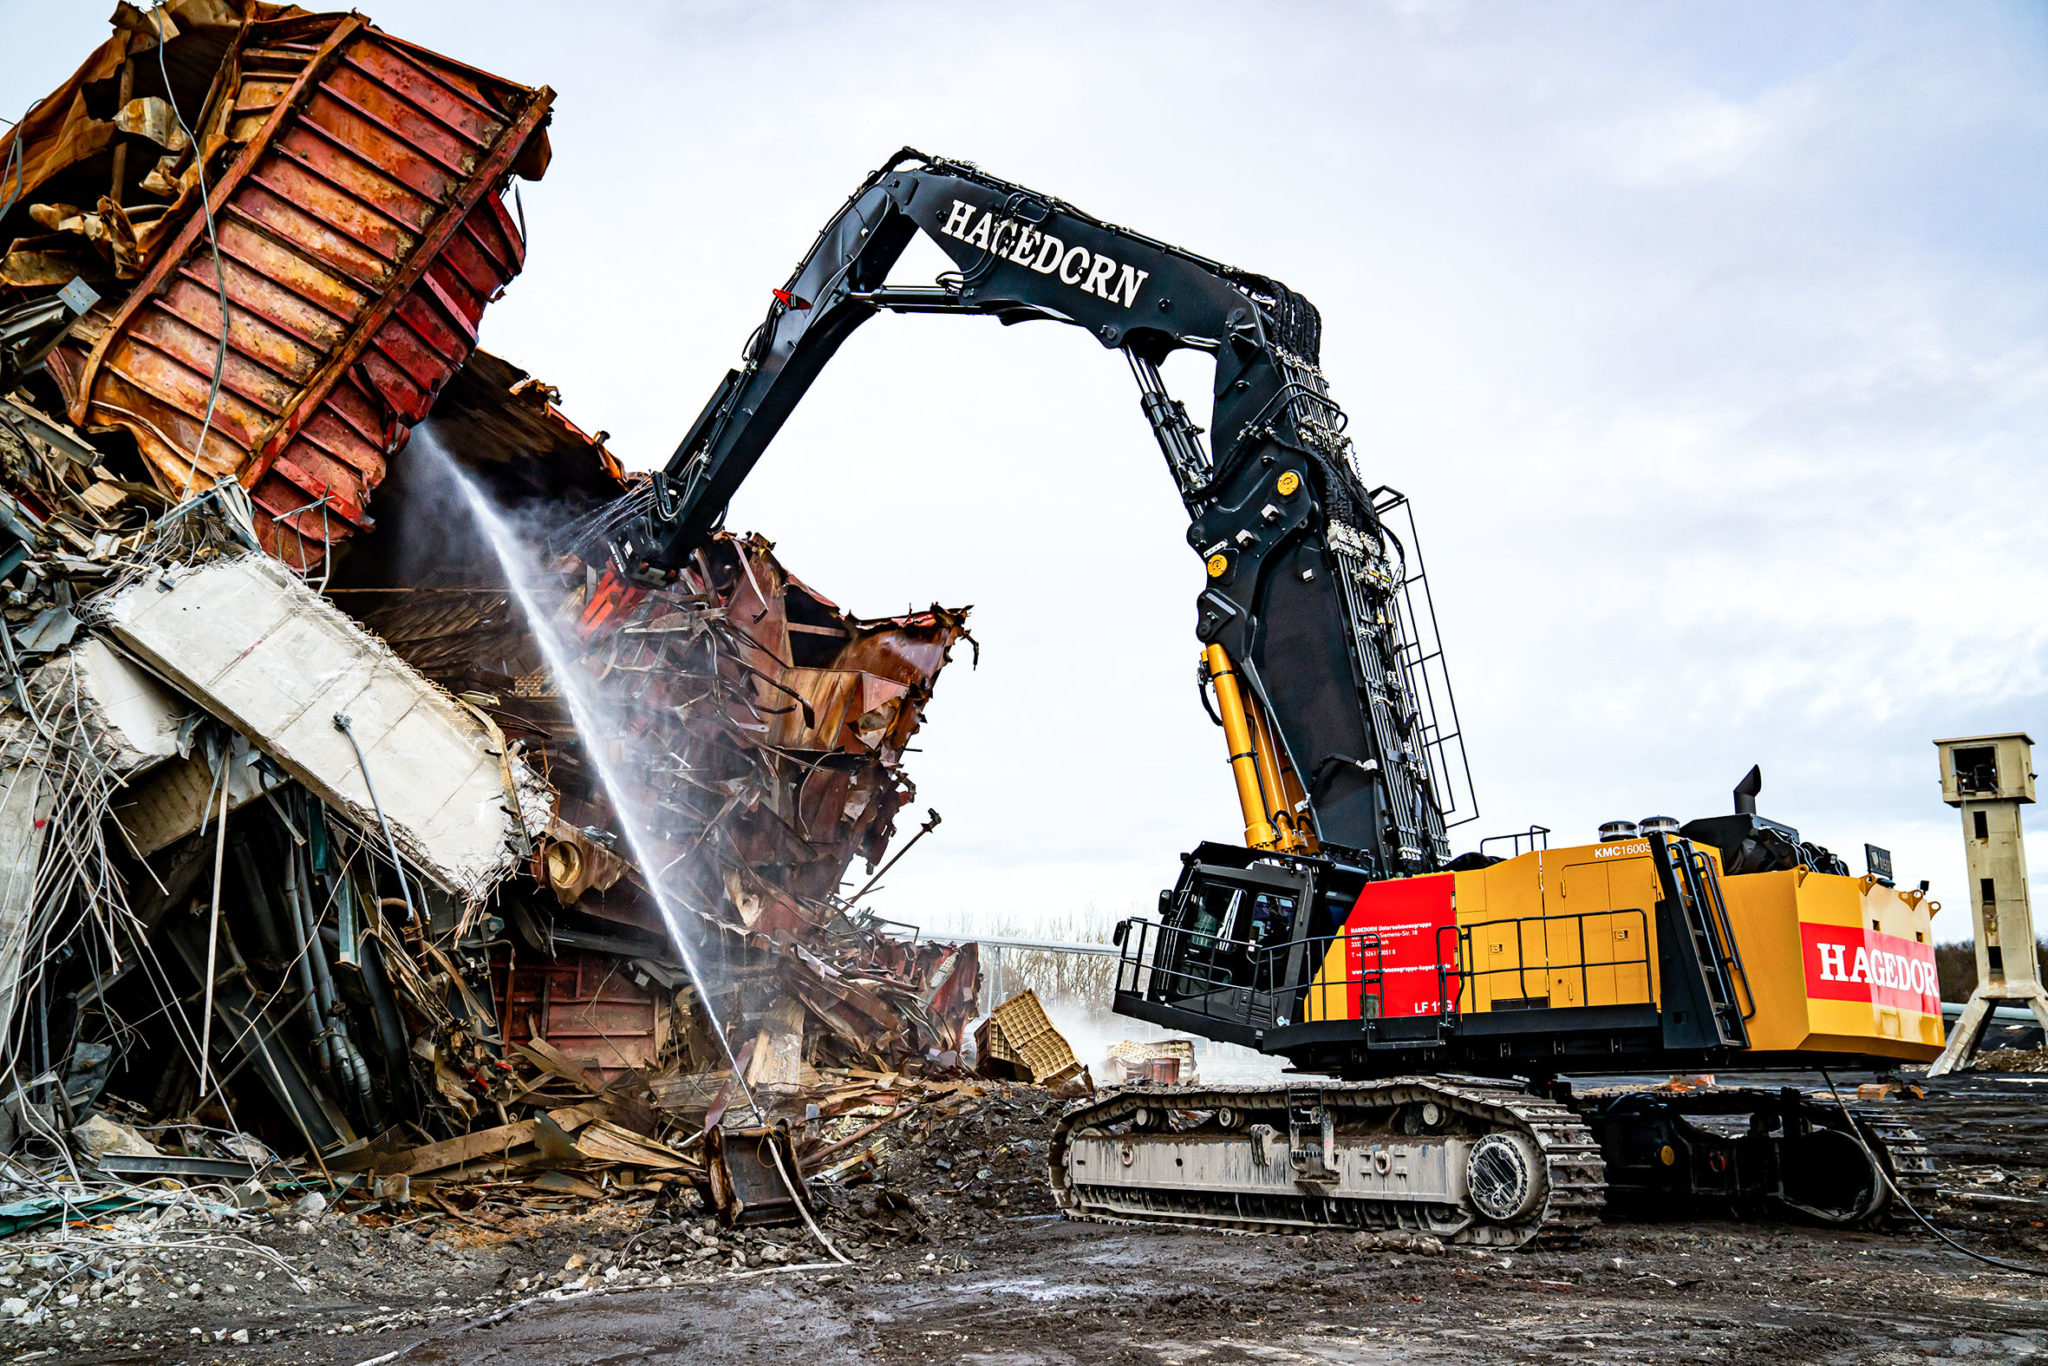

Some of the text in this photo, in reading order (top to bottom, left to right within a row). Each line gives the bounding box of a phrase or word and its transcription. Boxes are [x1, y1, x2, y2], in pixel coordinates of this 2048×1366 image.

[941, 199, 1149, 309] HAGEDORN
[1594, 842, 1652, 858] KMC1600S
[1816, 942, 1940, 998] HAGEDOR
[1414, 1001, 1429, 1014] LF
